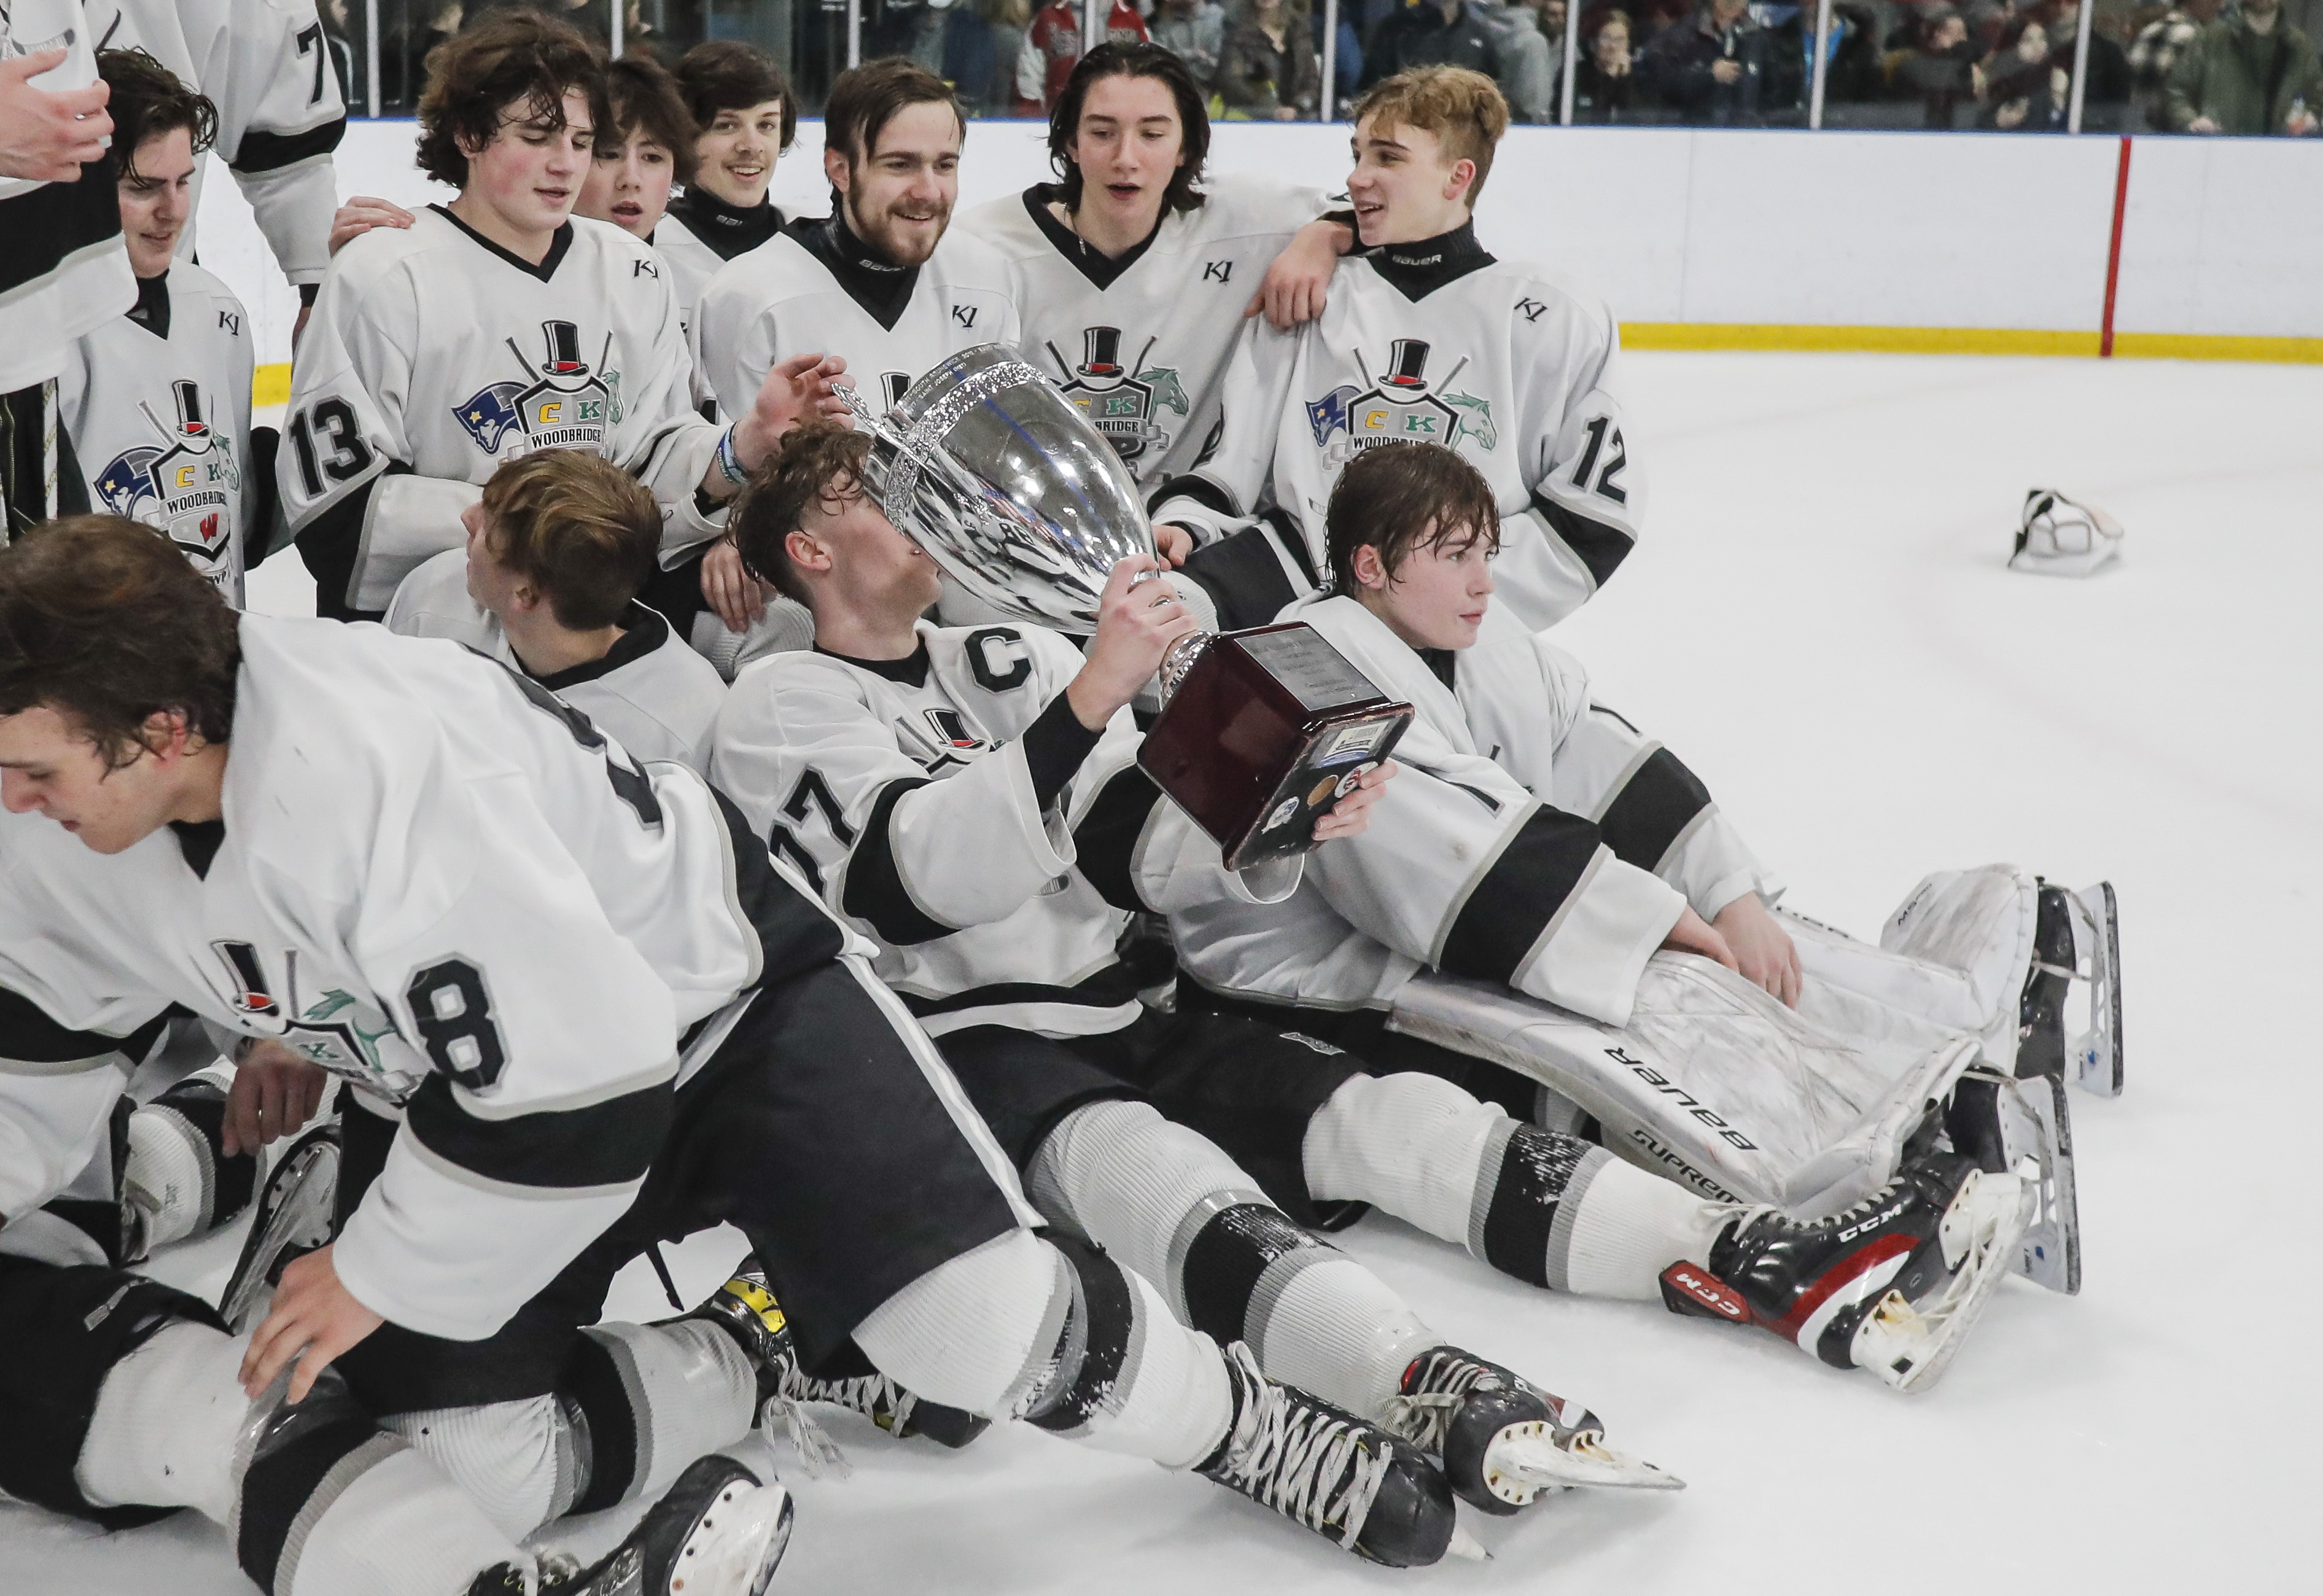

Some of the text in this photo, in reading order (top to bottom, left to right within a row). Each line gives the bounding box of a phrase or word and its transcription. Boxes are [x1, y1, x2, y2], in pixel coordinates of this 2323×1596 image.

[295, 18, 325, 108] 7
[539, 400, 601, 424] C K
[1094, 421, 1138, 432] BRIDGE
[1364, 410, 1437, 433] C K
[288, 394, 376, 500] 13
[531, 428, 601, 448] WOODBRIDGE
[175, 465, 195, 488] C
[1570, 415, 1627, 506] 12
[963, 626, 1033, 693] C
[402, 954, 510, 1092] 8
[1603, 1047, 1759, 1151] BAUER
[1837, 1202, 1902, 1244] CCM
[1675, 1272, 1741, 1315] CCM
